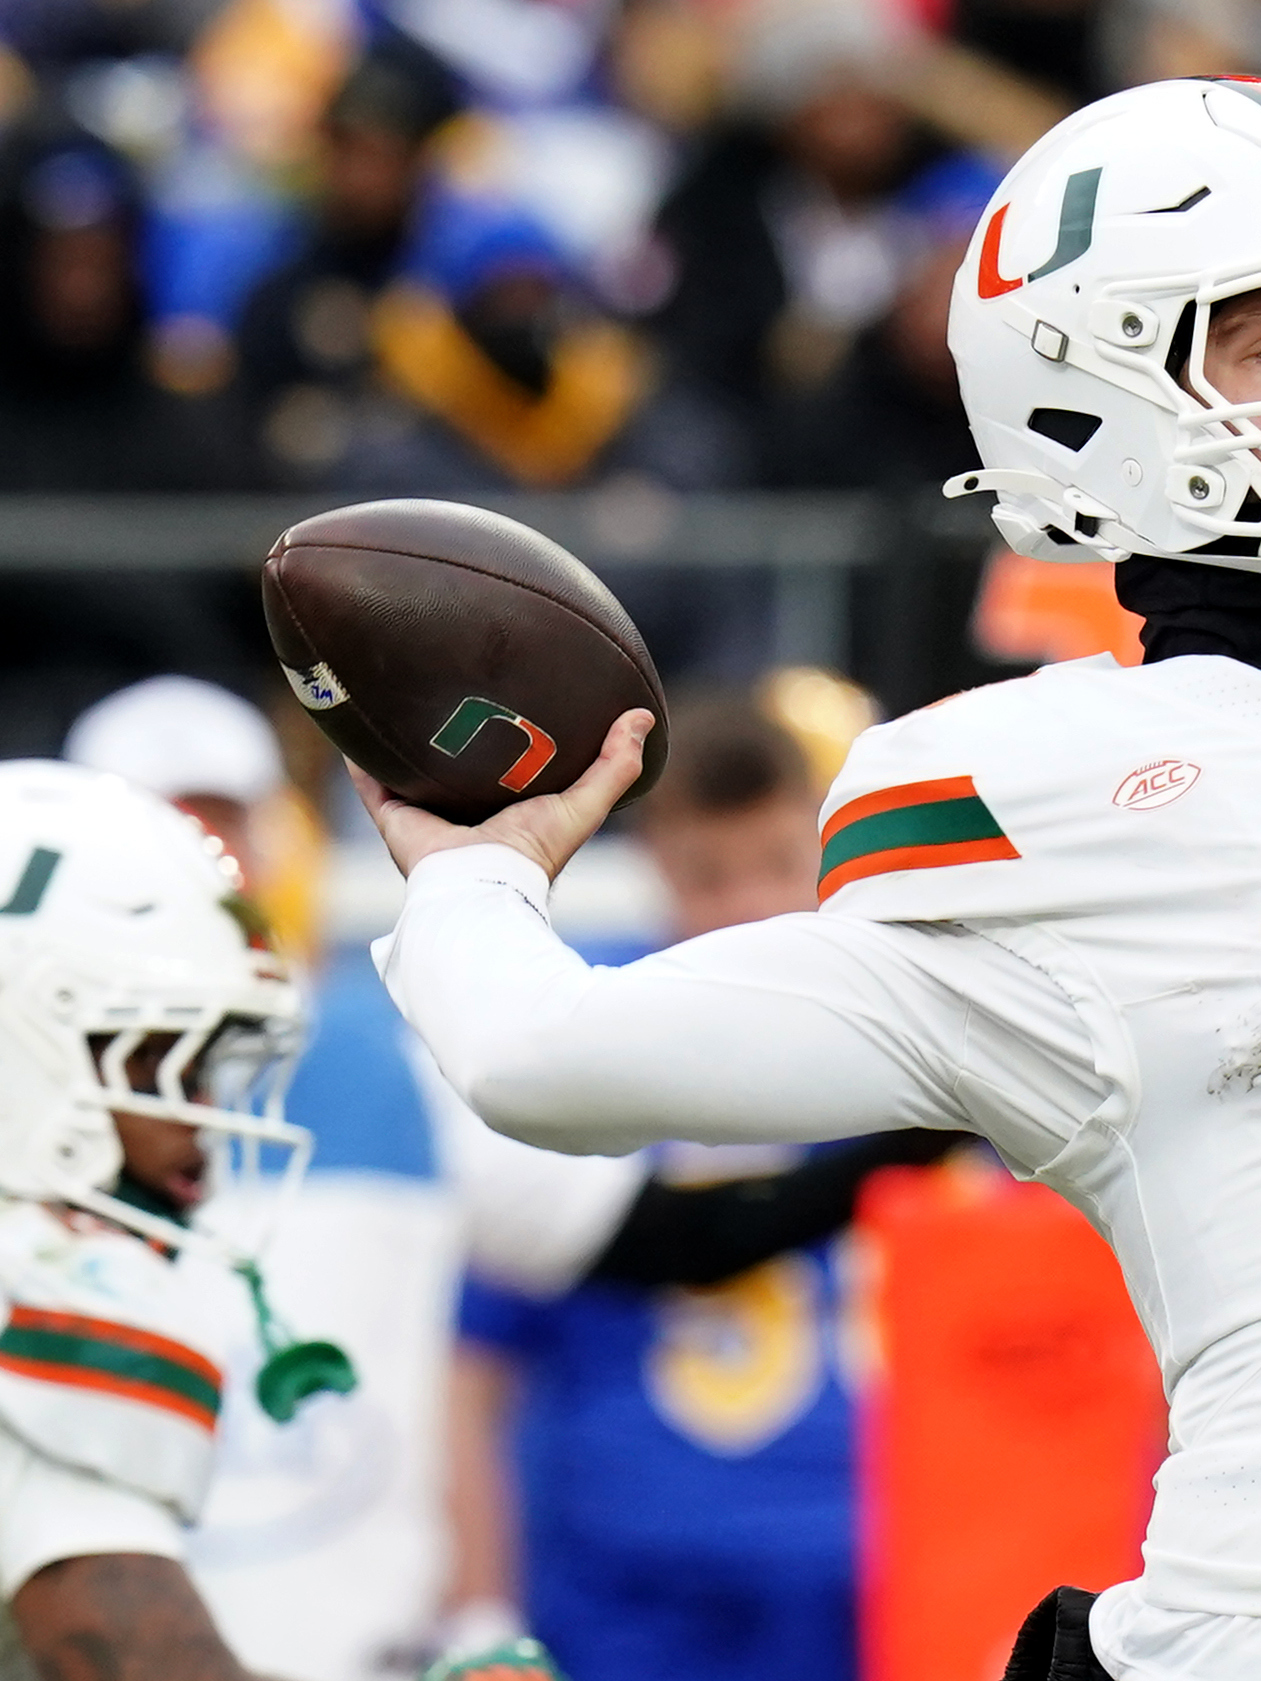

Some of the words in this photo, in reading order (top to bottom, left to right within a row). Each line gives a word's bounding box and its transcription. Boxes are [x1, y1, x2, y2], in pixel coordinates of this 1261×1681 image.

[977, 166, 1104, 300] U
[429, 696, 557, 793] U
[1127, 763, 1185, 801] ACC
